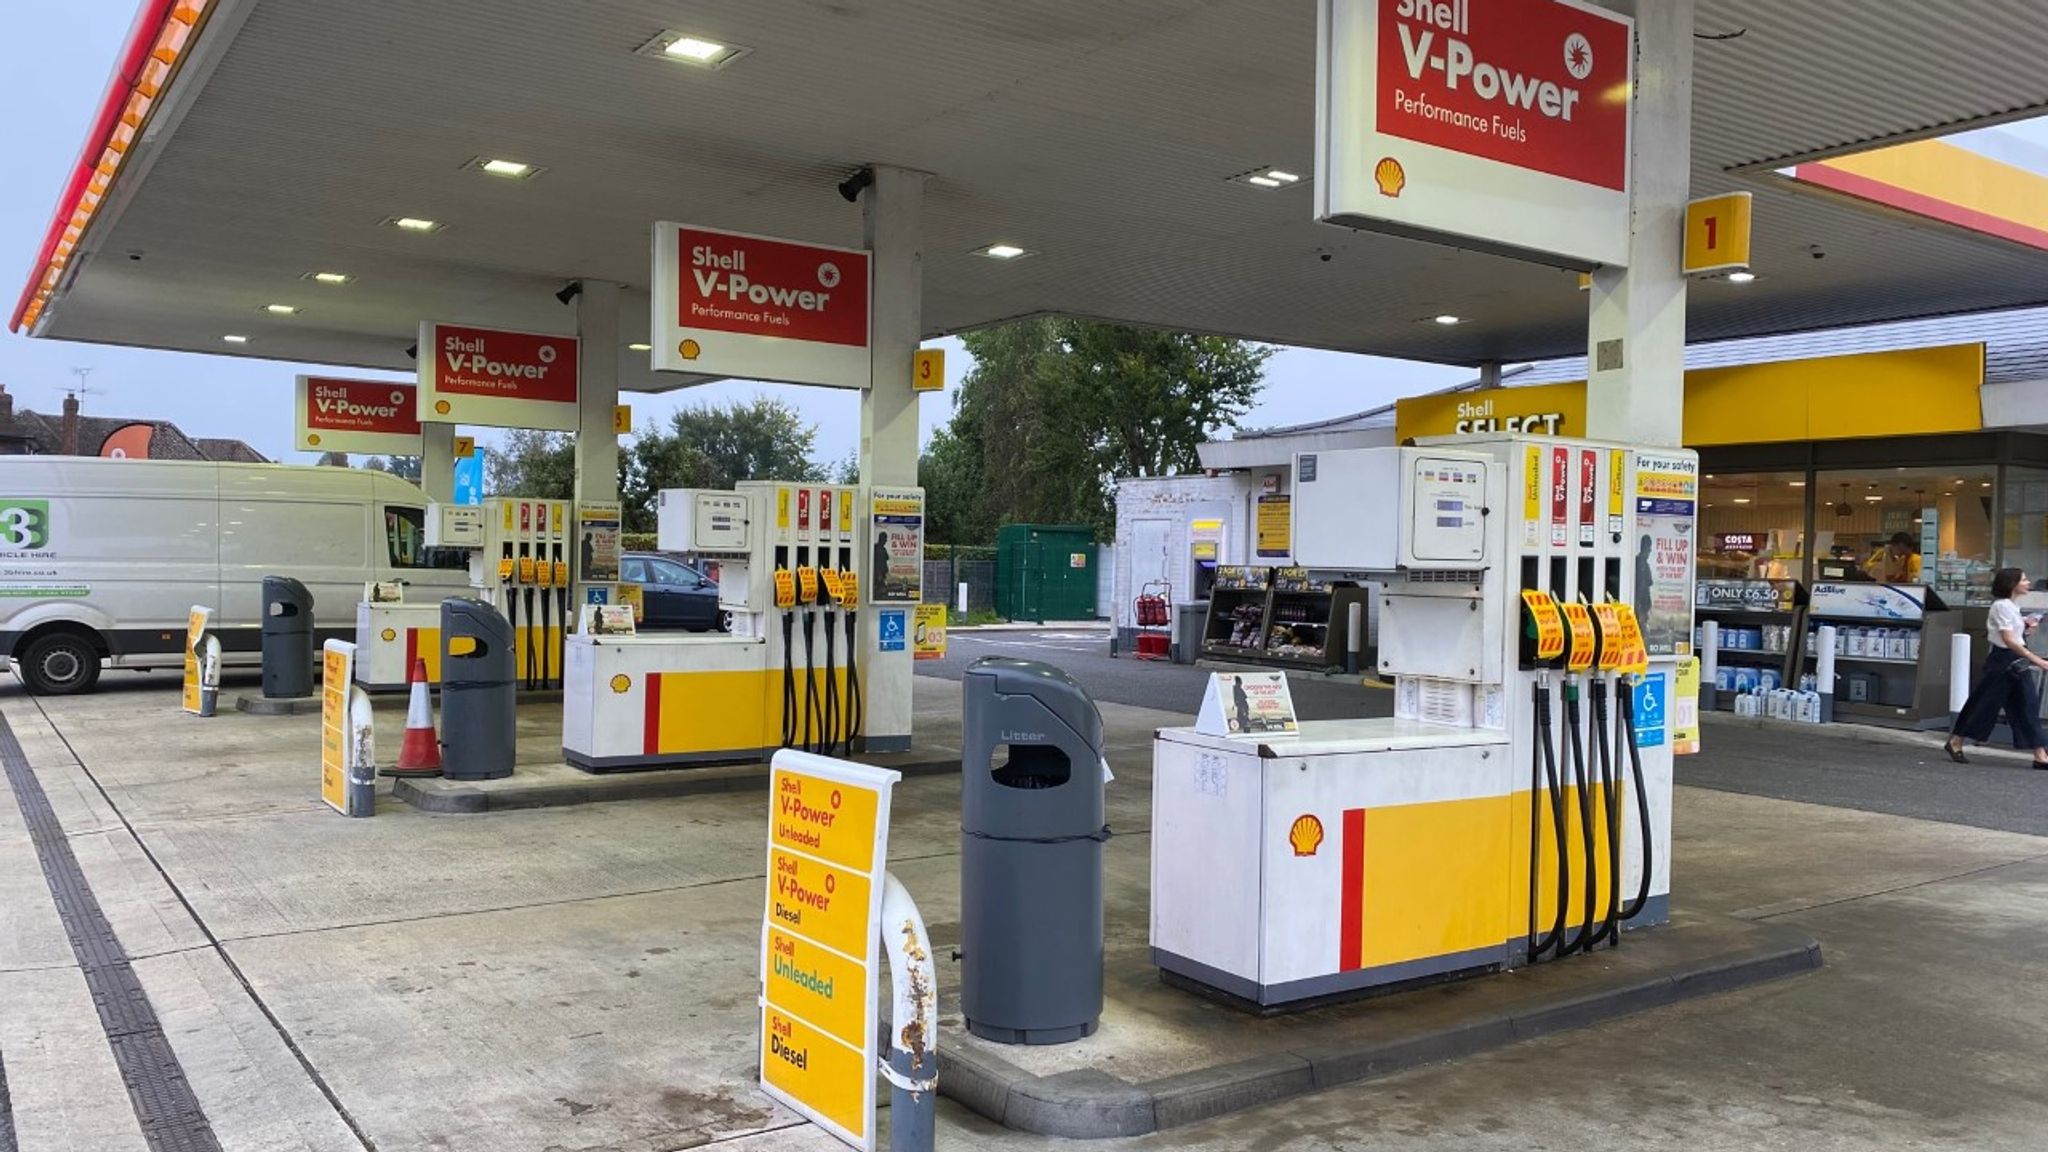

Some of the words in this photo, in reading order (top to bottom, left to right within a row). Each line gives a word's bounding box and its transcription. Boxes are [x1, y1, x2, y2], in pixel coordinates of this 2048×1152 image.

[1397, 0, 1469, 35] Shell
[1397, 21, 1579, 122] V-Power
[1394, 89, 1488, 133] Performance
[1492, 114, 1527, 143] Fuels
[1703, 216, 1717, 250] 1
[692, 246, 745, 271] Shell
[692, 269, 830, 311] V-Power
[691, 303, 760, 323] Performance
[763, 311, 790, 326] Fuels
[445, 336, 485, 353] Shell
[445, 352, 548, 379] V-Power
[921, 360, 931, 379] 3
[444, 375, 496, 388] Performance
[497, 379, 518, 390] Fuels
[315, 386, 347, 399] Shell
[315, 398, 398, 417] V-Power
[1457, 400, 1493, 418] Shell
[614, 411, 623, 427] 5
[458, 440, 469, 454] 7
[1636, 456, 1650, 467] For
[1653, 460, 1670, 471] your
[1671, 460, 1696, 473] safety
[899, 541, 917, 549] WIN
[1656, 538, 1674, 551] FILL
[1675, 539, 1689, 552] UP
[1724, 535, 1753, 545] COSTA
[1656, 552, 1664, 564] &
[1667, 552, 1688, 565] WIN
[1711, 588, 1743, 599] ONLY
[1744, 589, 1779, 600] £6.50
[1814, 585, 1846, 595] AdBlue
[928, 631, 943, 643] 03
[1677, 705, 1692, 724] 01
[1001, 730, 1046, 741] Litter
[780, 777, 801, 796] Shell
[780, 794, 836, 828] V-Power
[779, 822, 820, 848] Unleaded
[777, 856, 798, 875] Shell
[777, 873, 830, 911] V-Power
[775, 902, 801, 925] Diesel
[774, 935, 795, 957] Shell
[774, 955, 833, 999] Unleaded
[772, 1016, 792, 1038] Shell
[771, 1034, 808, 1071] Diesel
